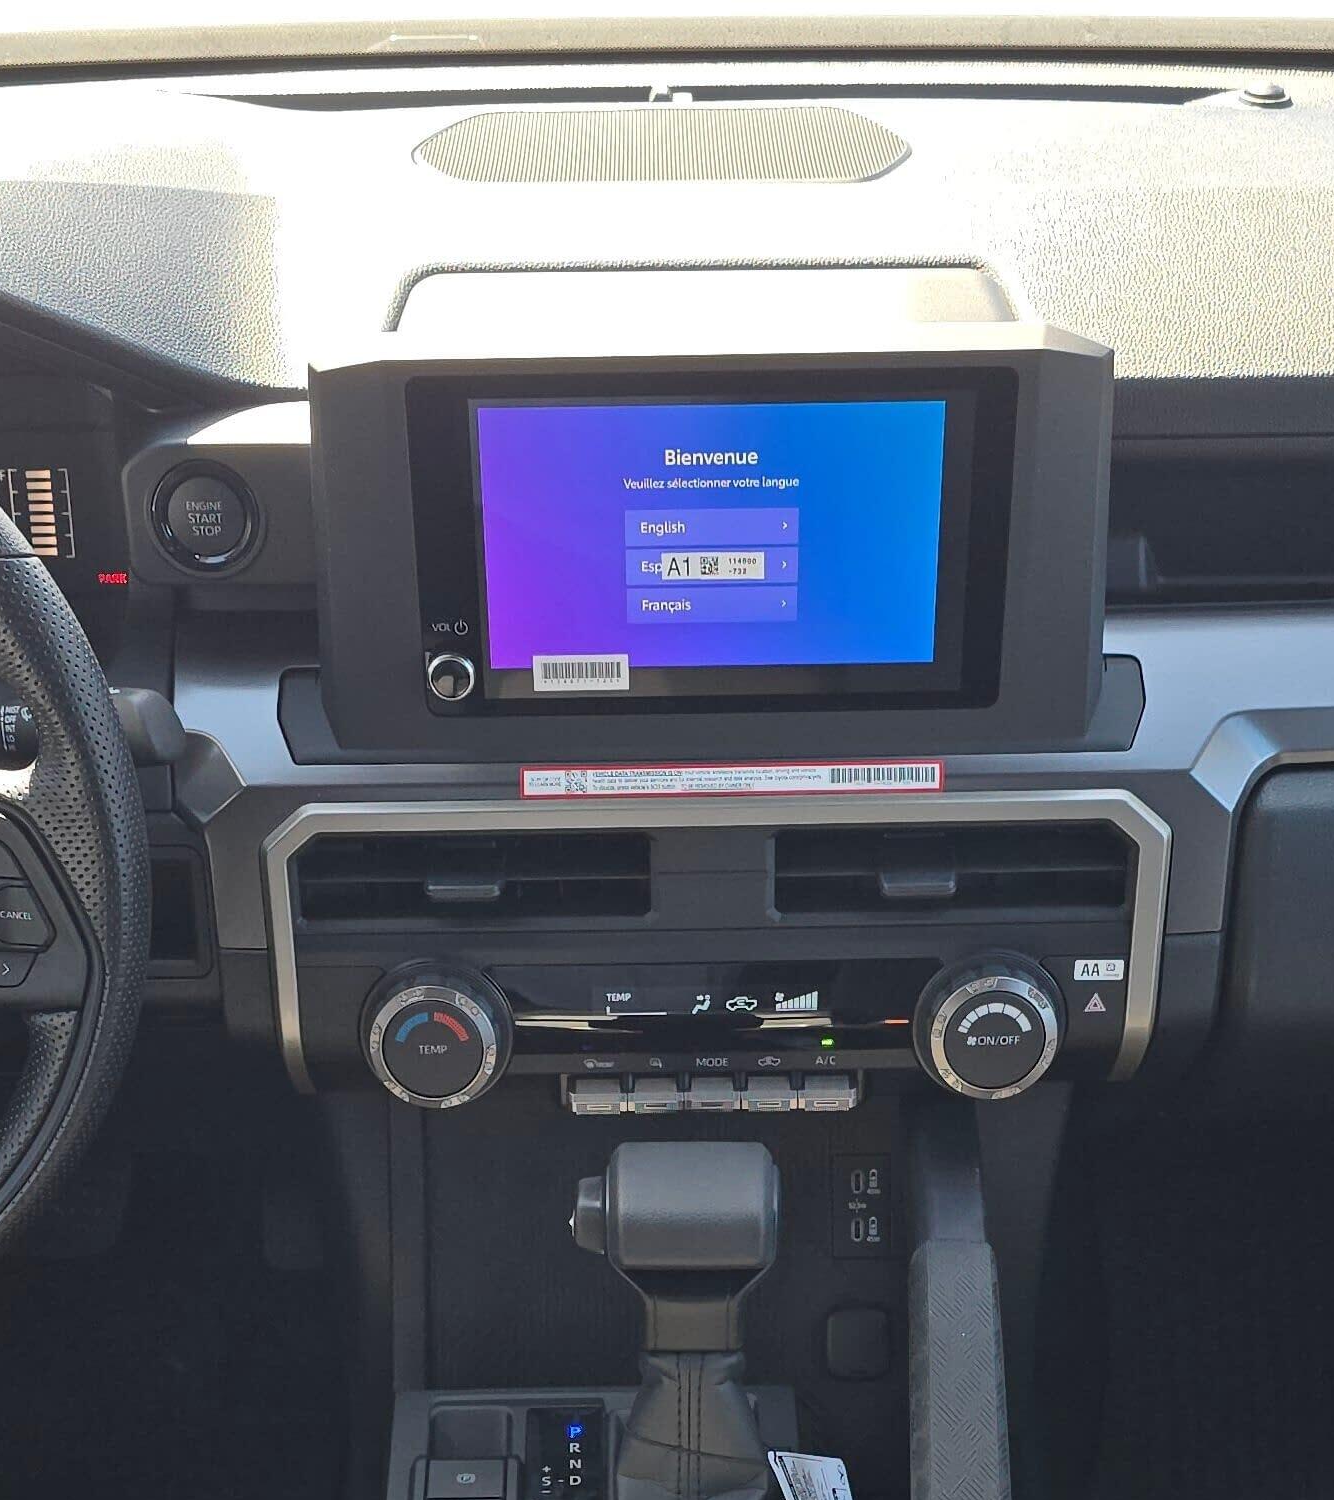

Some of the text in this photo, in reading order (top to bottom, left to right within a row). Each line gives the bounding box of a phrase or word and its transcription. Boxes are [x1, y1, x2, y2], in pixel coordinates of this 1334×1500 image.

[665, 449, 759, 466] Bienvenue
[623, 476, 799, 490] Veuillez sélectionner votre langue
[186, 501, 222, 511] ENGINE
[188, 513, 222, 524] START
[192, 526, 222, 536] STOP
[640, 521, 686, 536] English
[667, 557, 691, 577] A1
[642, 599, 691, 614] Français
[432, 624, 450, 632] VOL
[0, 911, 33, 920] CANCEL
[1081, 963, 1100, 976] AA
[606, 993, 631, 1002] TEMP
[978, 1035, 1020, 1046] ON/OFF
[419, 1045, 447, 1054] TEMP
[696, 1057, 729, 1067] MODE
[815, 1056, 836, 1065] A/C
[569, 1426, 582, 1439] P
[569, 1443, 581, 1453] R
[569, 1459, 581, 1469] N
[541, 1476, 551, 1486] S
[569, 1475, 581, 1486] D
